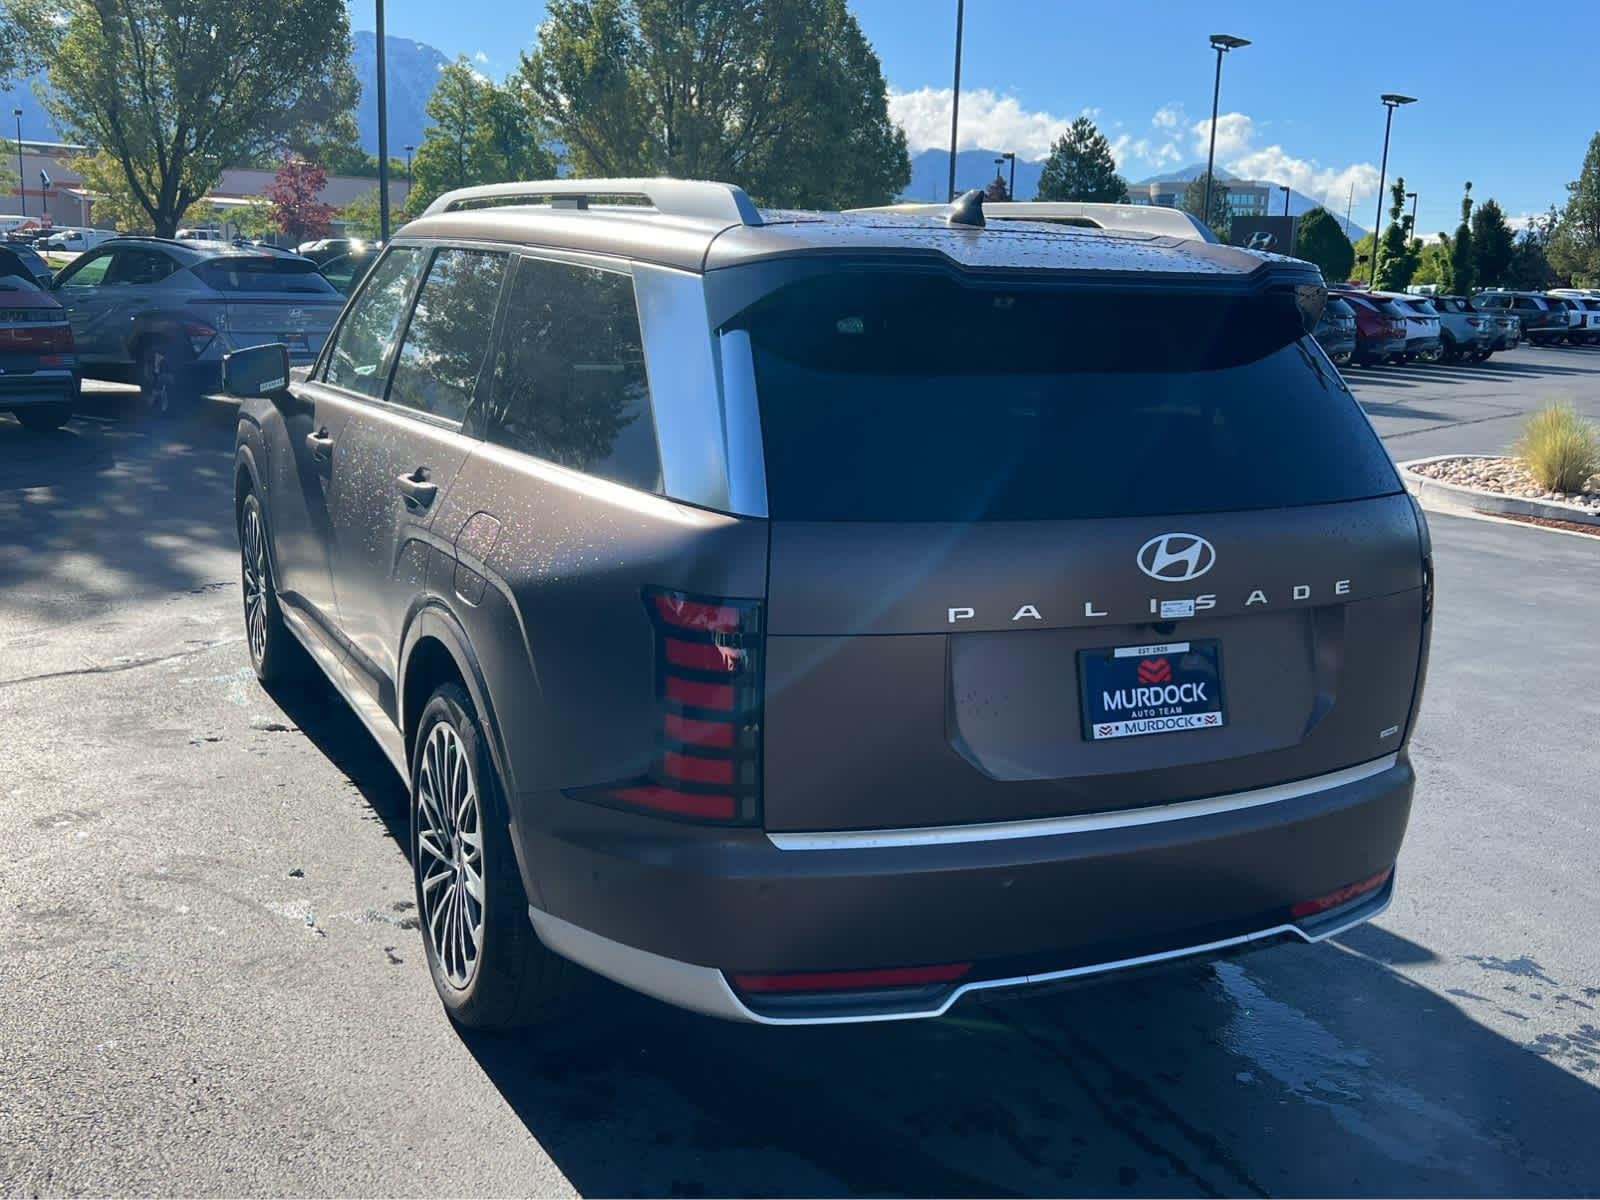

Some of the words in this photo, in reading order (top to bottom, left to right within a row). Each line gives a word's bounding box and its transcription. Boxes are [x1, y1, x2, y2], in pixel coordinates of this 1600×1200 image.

[947, 579, 1350, 623] PALISADE
[1138, 647, 1150, 655] EST
[1103, 681, 1208, 711] MURDOCK
[1131, 708, 1156, 719] AUTO
[1159, 706, 1183, 716] TEAM
[1124, 716, 1195, 734] MURDOCK
